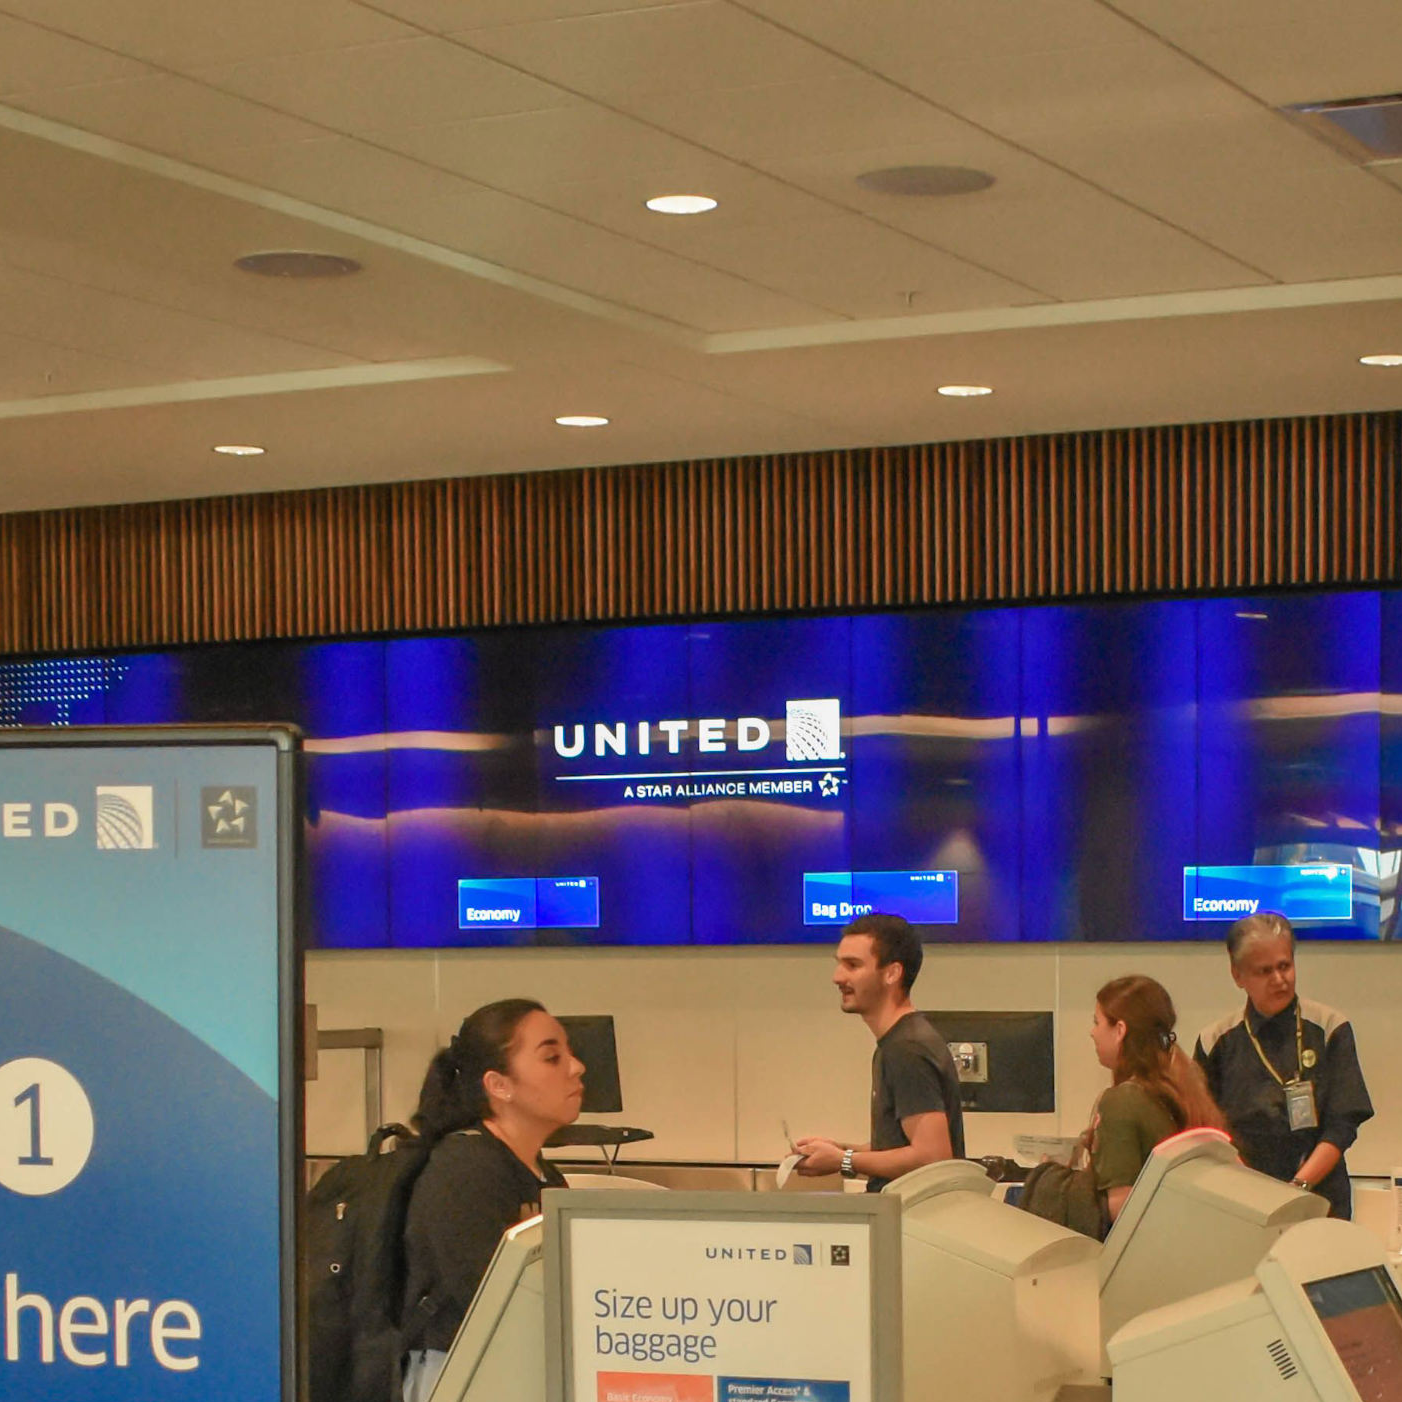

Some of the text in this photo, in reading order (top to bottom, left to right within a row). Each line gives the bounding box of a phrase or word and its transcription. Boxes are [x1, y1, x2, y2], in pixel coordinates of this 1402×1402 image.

[554, 717, 770, 758] UNITED
[623, 780, 812, 798] A STAR ALLIANCE MEMBER
[466, 908, 520, 922] Economy
[812, 903, 837, 918] Bag
[1193, 898, 1259, 914] Economy
[13, 1081, 54, 1167] 1
[705, 1247, 787, 1260] UNITED
[594, 1289, 777, 1327] Size up your
[4, 1273, 202, 1372] here
[595, 1325, 717, 1363] baggage
[728, 1384, 764, 1395] Premier
